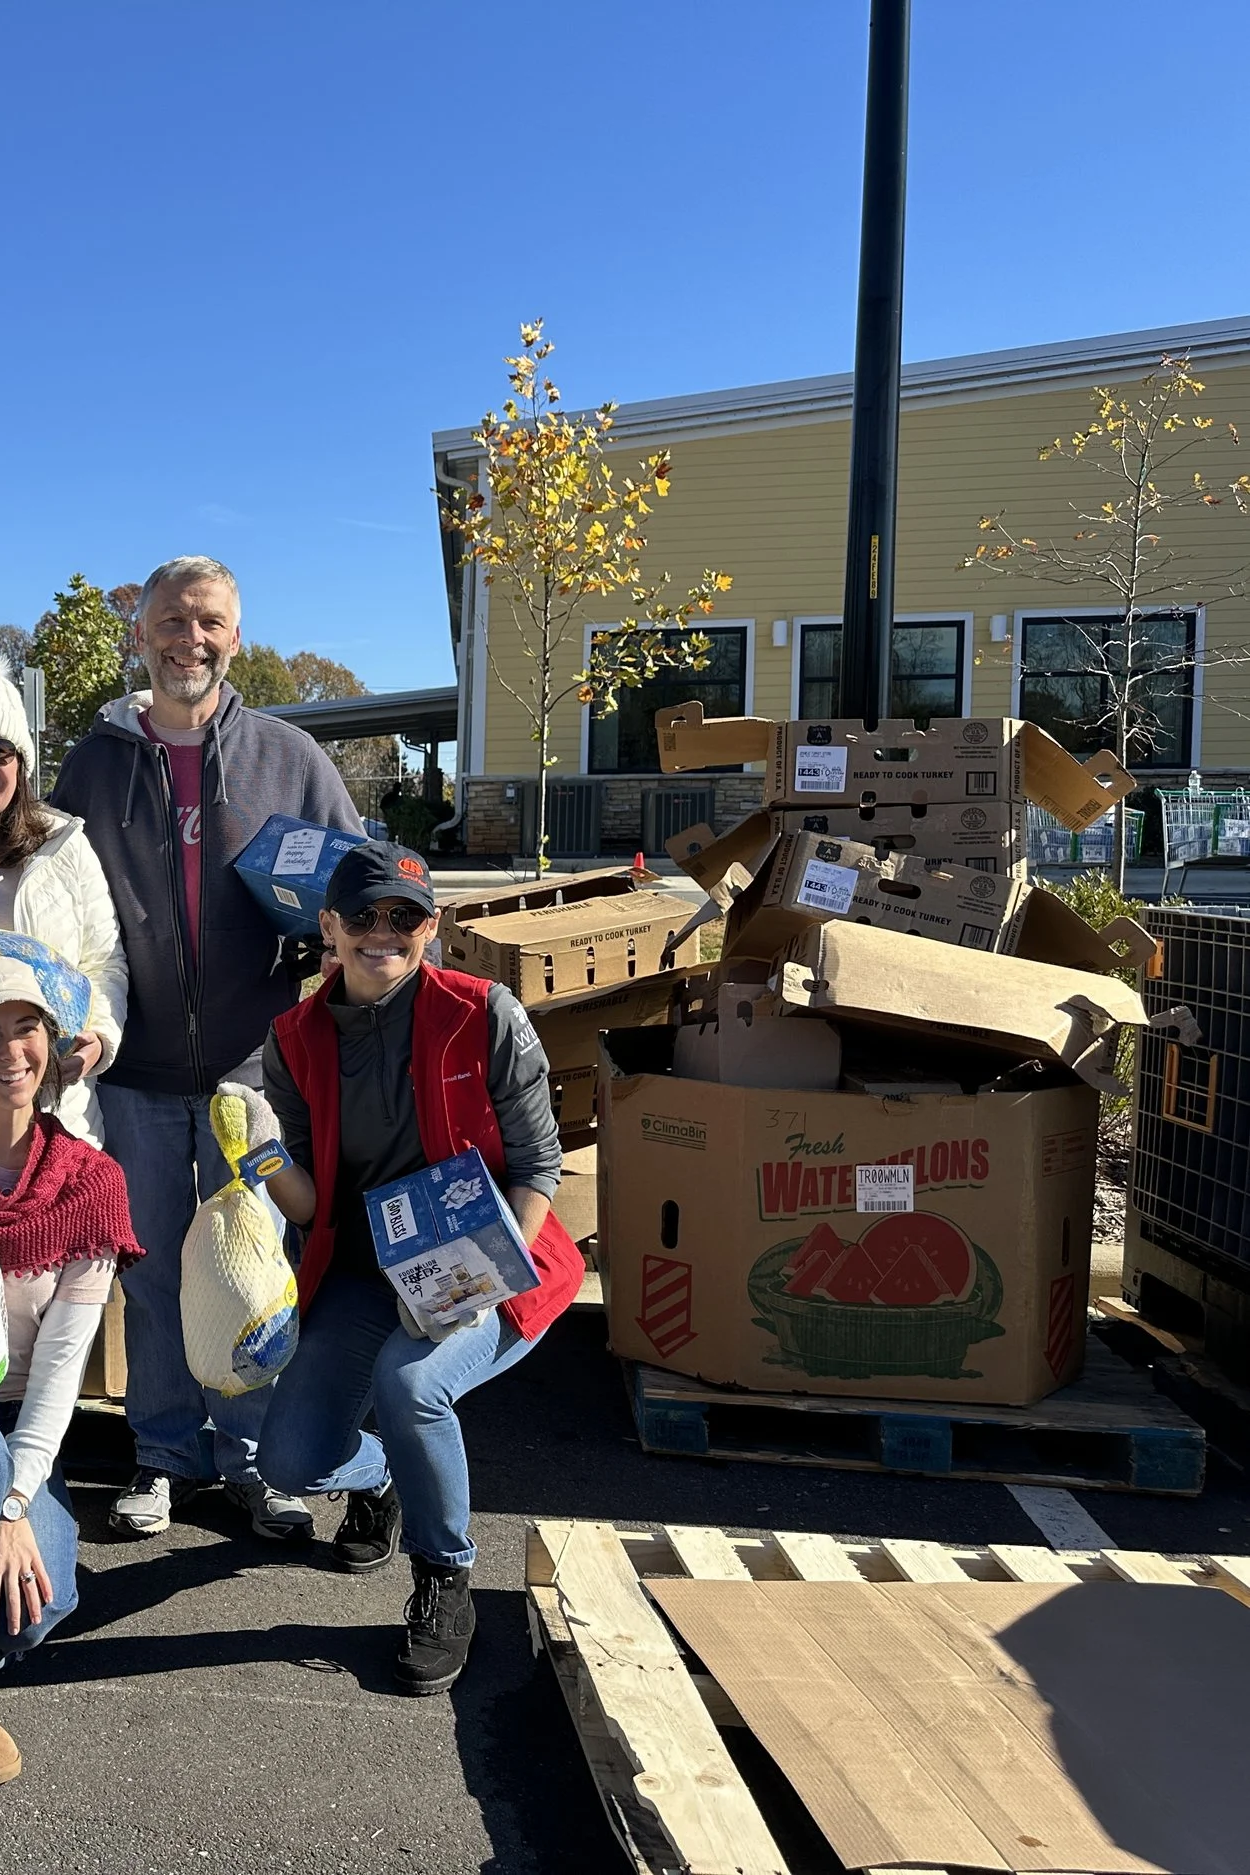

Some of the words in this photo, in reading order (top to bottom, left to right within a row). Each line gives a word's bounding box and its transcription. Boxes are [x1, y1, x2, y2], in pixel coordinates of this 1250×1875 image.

[775, 726, 783, 760] PRODUCT
[775, 761, 783, 770] OF
[1014, 751, 1022, 761] OF
[798, 768, 820, 777] 1443
[853, 771, 880, 780] READY
[882, 771, 894, 780] TO
[895, 771, 919, 780] COOK
[921, 771, 954, 780] TURKEY
[1014, 762, 1022, 795] PRODUCT
[780, 834, 795, 866] PRODUCT
[777, 867, 786, 875] OF
[804, 880, 828, 892] 1443
[530, 902, 593, 917] PERISHABLE
[852, 896, 880, 908] READY
[881, 902, 892, 911] TO
[893, 905, 917, 918] COOK
[919, 912, 953, 926] TURKEY
[570, 936, 593, 948] READY
[594, 933, 604, 942] TO
[605, 931, 624, 941] COOK
[625, 924, 652, 936] TURKEY
[570, 993, 630, 1014] PERISHABLE
[653, 1119, 707, 1140] ClimaBin
[765, 1109, 807, 1135] 371
[247, 1145, 279, 1168] Premium
[785, 1132, 846, 1160] Fresh
[762, 1138, 990, 1213] WATELONS
[858, 1169, 910, 1184] TR00WMLN
[398, 1268, 415, 1279] FOOD
[421, 1259, 437, 1269] LION
